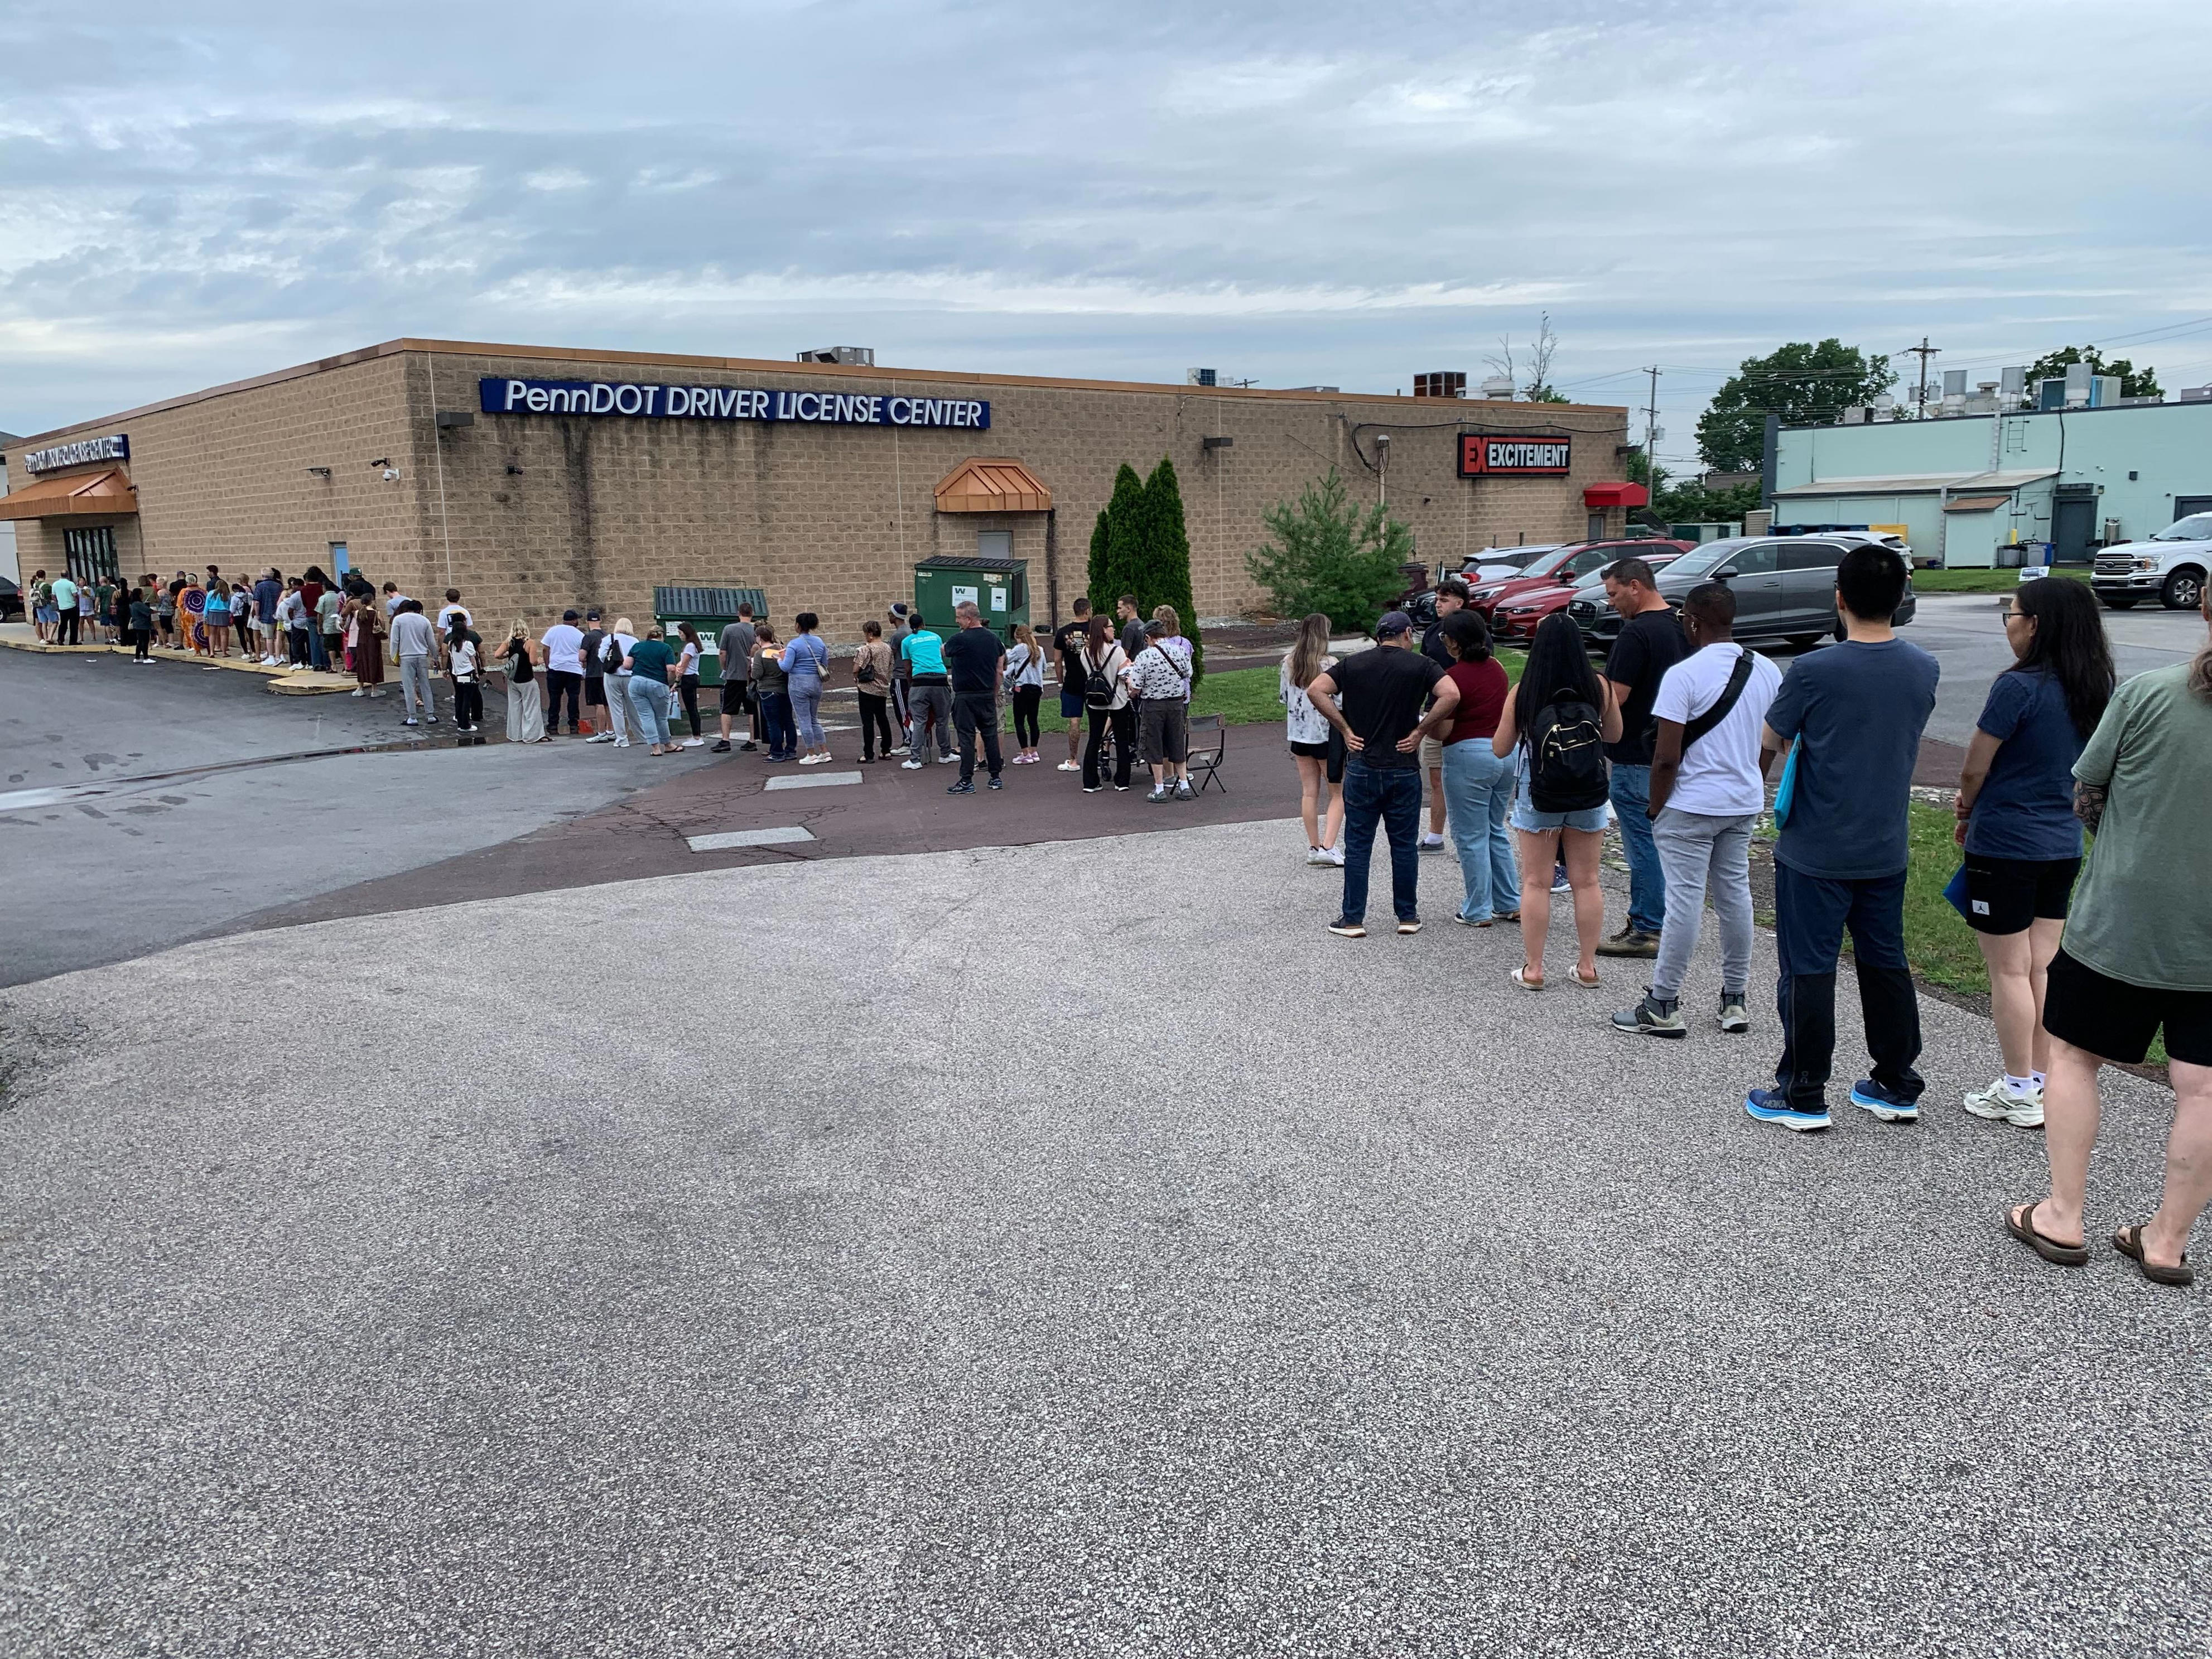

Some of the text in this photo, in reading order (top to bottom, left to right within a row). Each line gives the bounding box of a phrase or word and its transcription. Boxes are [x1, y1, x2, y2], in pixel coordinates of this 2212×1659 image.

[504, 380, 982, 427] PennDOT DRIVER LICENSE CENTER
[1464, 437, 1569, 472] EX EXCITEMENT
[1762, 1099, 1787, 1108] HOKA
